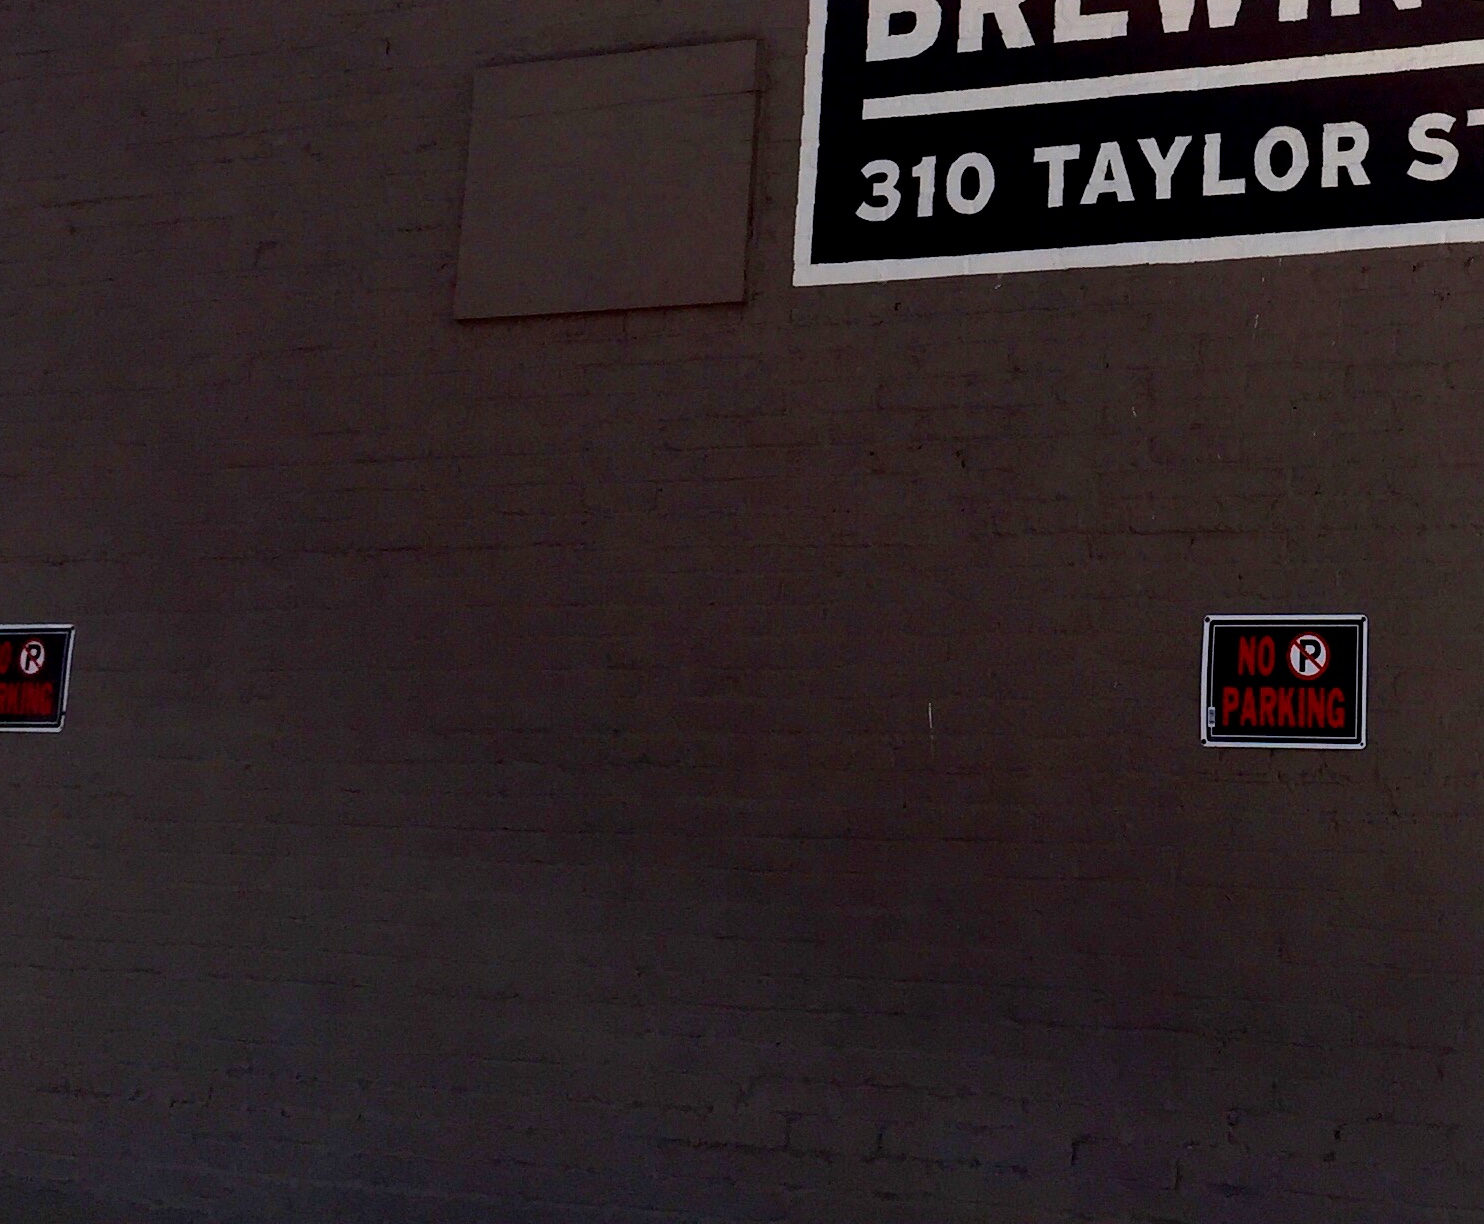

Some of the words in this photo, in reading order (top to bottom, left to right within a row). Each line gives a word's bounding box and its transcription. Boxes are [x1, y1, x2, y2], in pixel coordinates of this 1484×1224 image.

[855, 151, 996, 222] 310
[1033, 121, 1371, 209] TAYLOR
[1238, 635, 1276, 676] NO
[1222, 686, 1345, 728] PARKING
